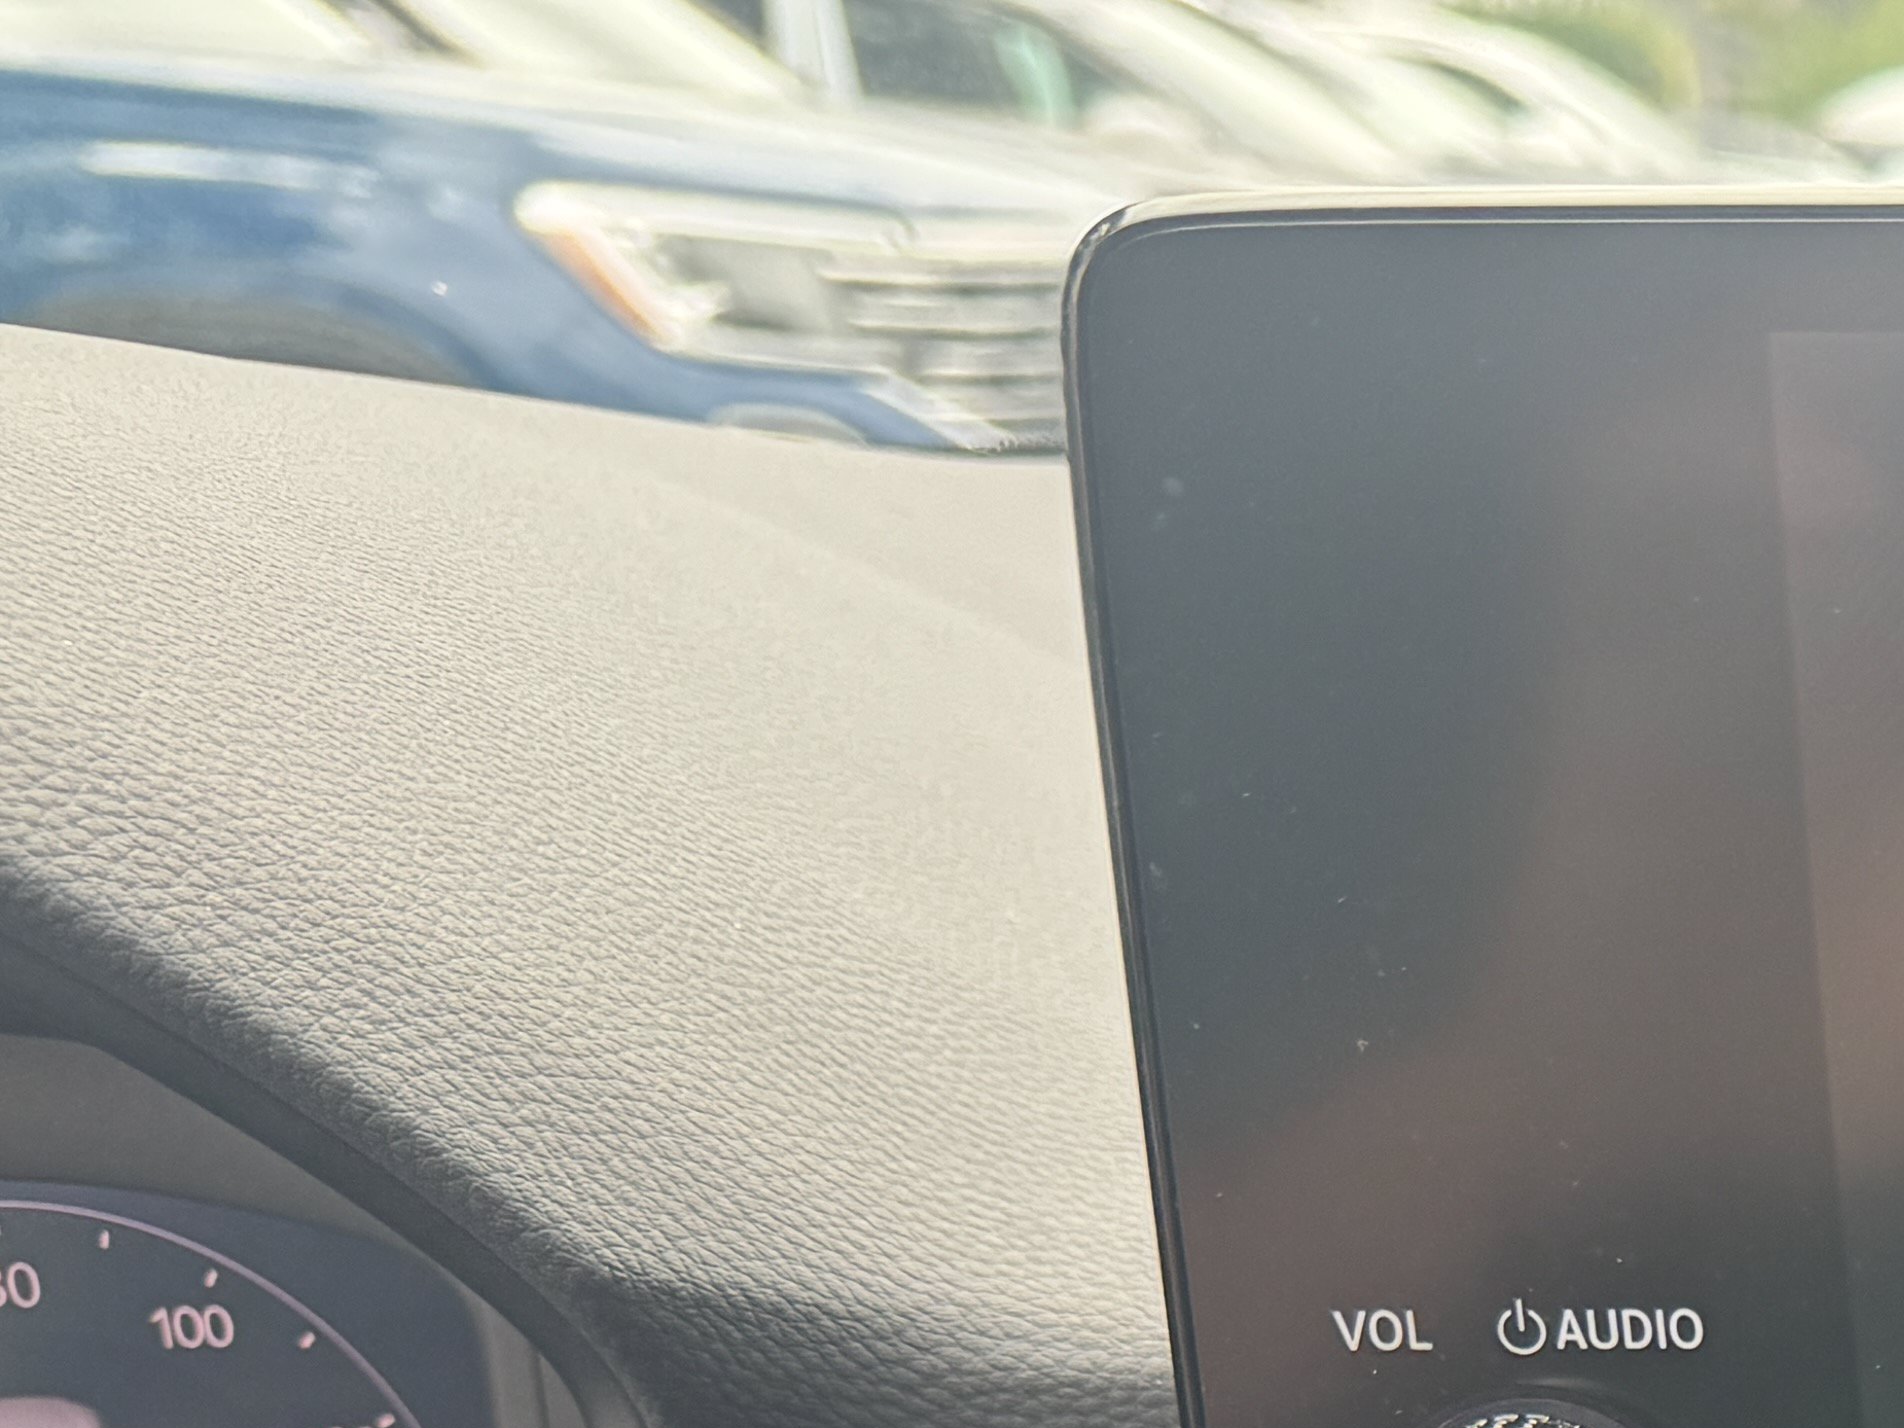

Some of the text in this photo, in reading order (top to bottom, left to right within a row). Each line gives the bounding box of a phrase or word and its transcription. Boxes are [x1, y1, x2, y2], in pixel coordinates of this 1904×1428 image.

[0, 1261, 41, 1309] 0
[149, 1303, 235, 1350] 100
[1331, 1307, 1705, 1353] VOL AUDIO
